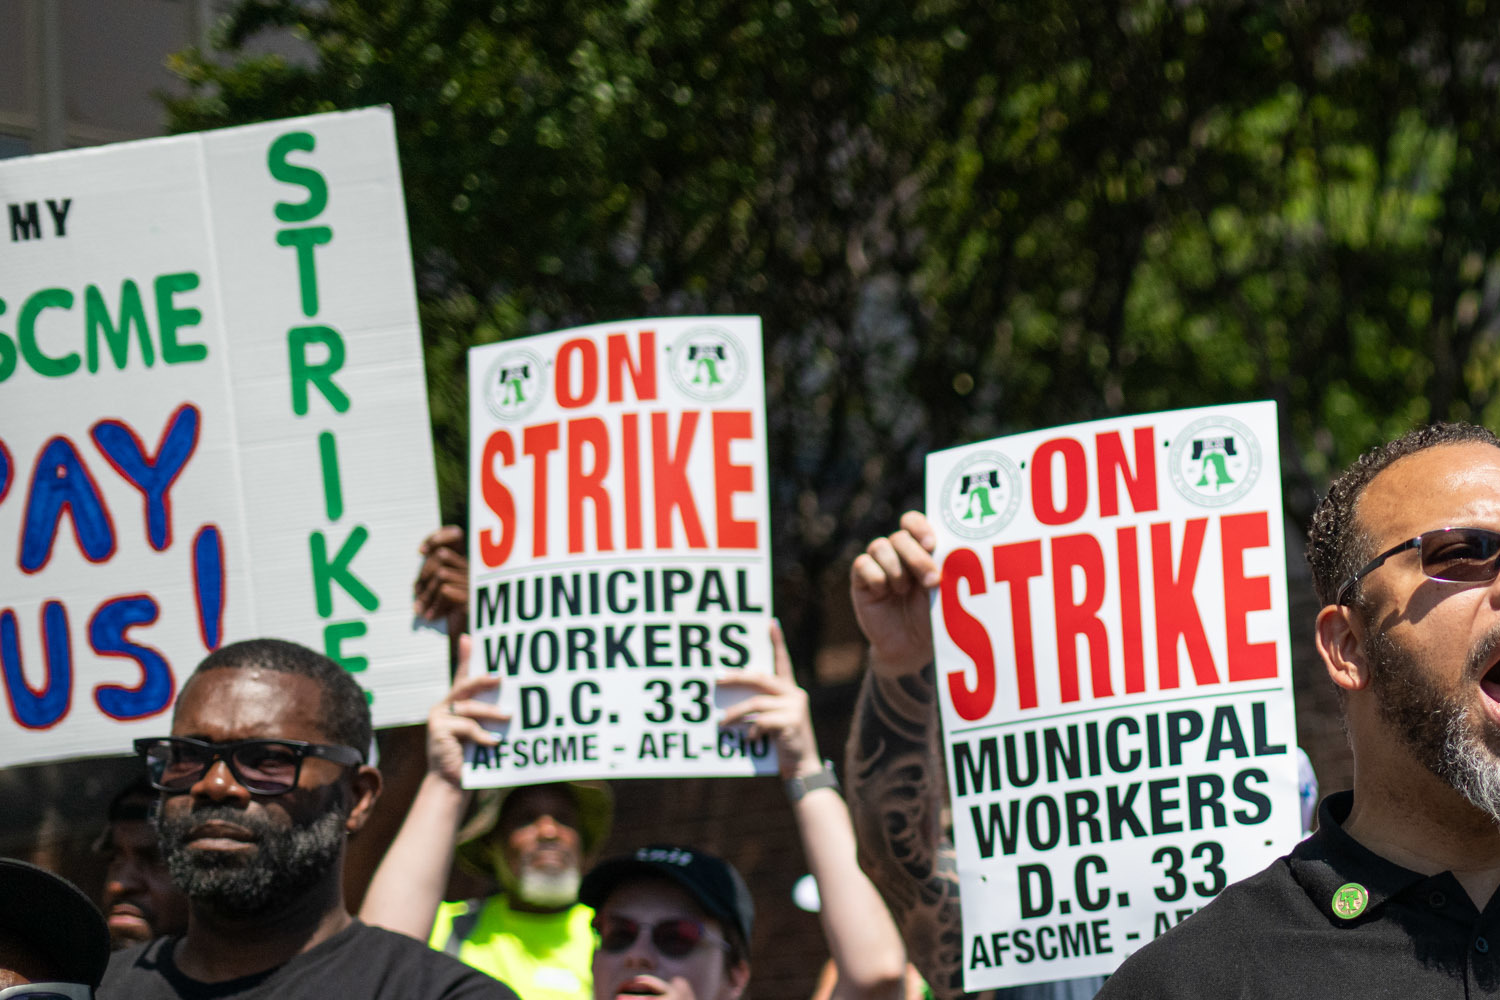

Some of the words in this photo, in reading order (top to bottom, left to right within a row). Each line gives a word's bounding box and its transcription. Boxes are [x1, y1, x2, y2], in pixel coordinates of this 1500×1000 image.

[8, 198, 72, 242] MY
[554, 330, 657, 409] ON
[0, 402, 202, 576] AY
[478, 410, 759, 569] STRIKE
[1030, 426, 1158, 526] ON
[476, 569, 763, 629] MUNICIPAL
[940, 511, 1278, 721] STRIKE
[484, 623, 751, 677] WORKERS
[519, 681, 620, 731] D.C.
[644, 680, 710, 726] 33
[471, 734, 598, 771] AFSCME
[638, 730, 770, 760] AFL-CIO
[952, 702, 1287, 797] MUNICIPAL
[970, 769, 1272, 859] WORKERS
[1018, 854, 1130, 919] D.C.
[1151, 841, 1227, 902] 33
[969, 919, 1113, 970] AFSCME
